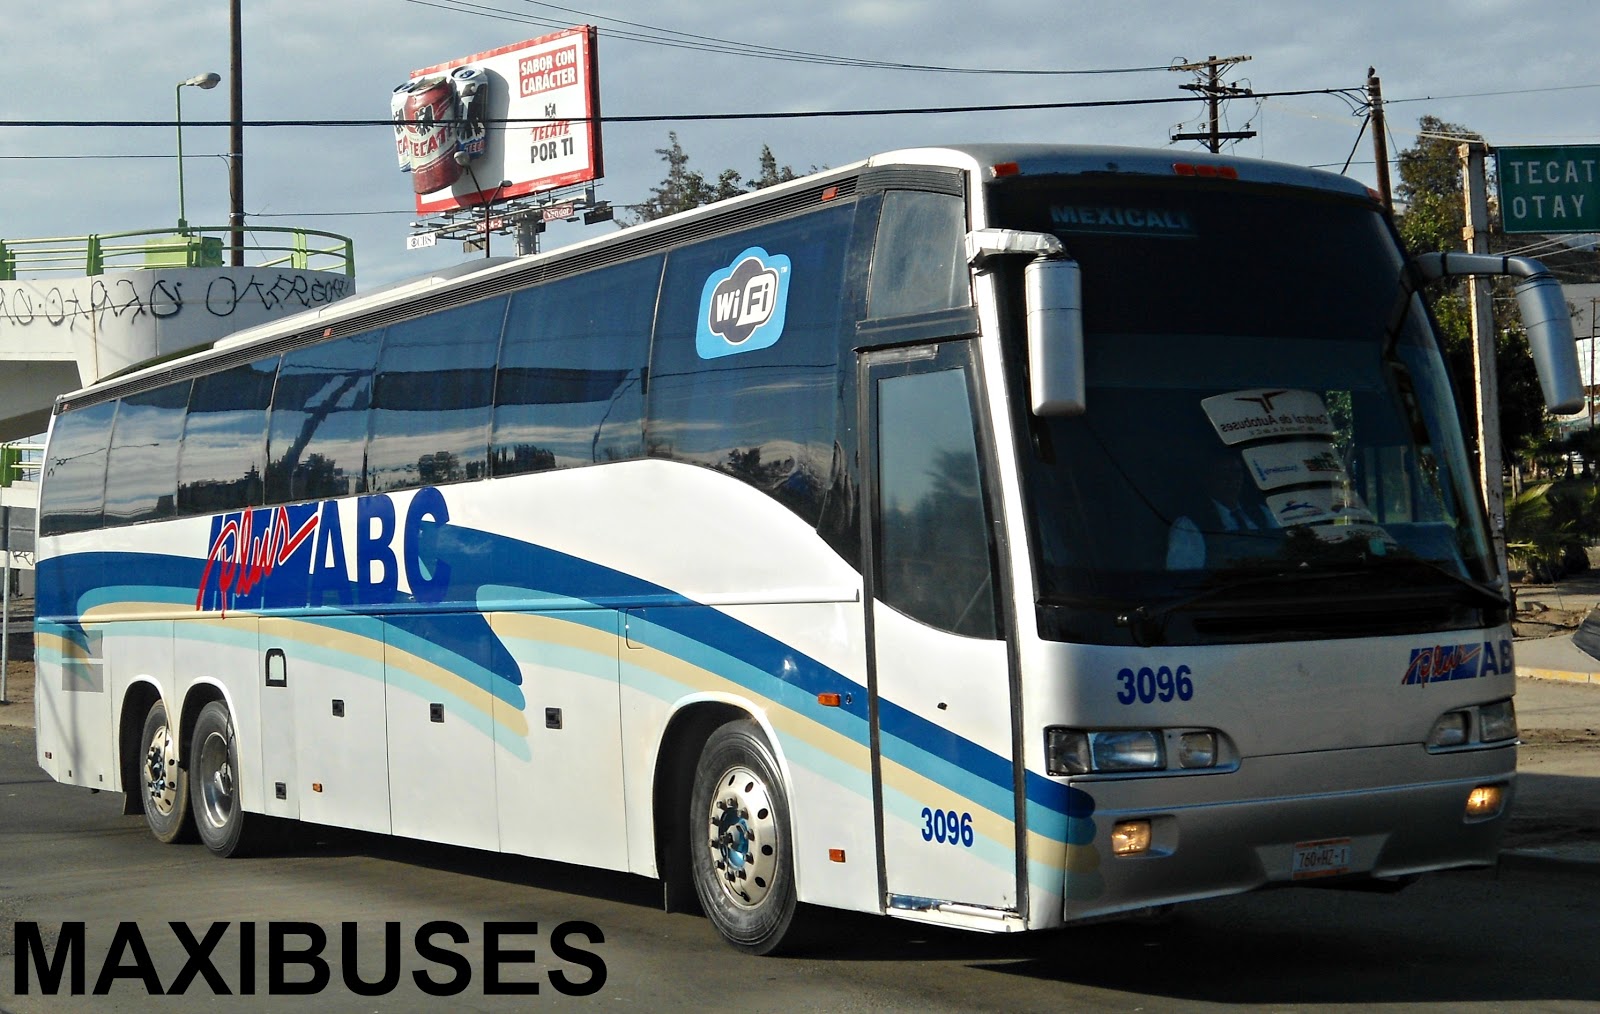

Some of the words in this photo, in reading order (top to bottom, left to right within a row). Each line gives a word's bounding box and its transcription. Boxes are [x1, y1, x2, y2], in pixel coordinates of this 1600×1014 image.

[520, 54, 553, 77] SABOR
[555, 48, 575, 67] CON
[521, 68, 576, 95] CARÁCTER
[465, 138, 486, 153] TECA
[530, 140, 557, 164] POR
[560, 136, 574, 156] TI
[1509, 160, 1600, 185] TECAT
[1049, 205, 1192, 229] MEXICALI
[1512, 194, 1585, 219] OTAY
[311, 485, 451, 606] ABC
[1480, 639, 1513, 678] AB
[1116, 664, 1194, 706] 3096
[921, 806, 974, 848] 3096
